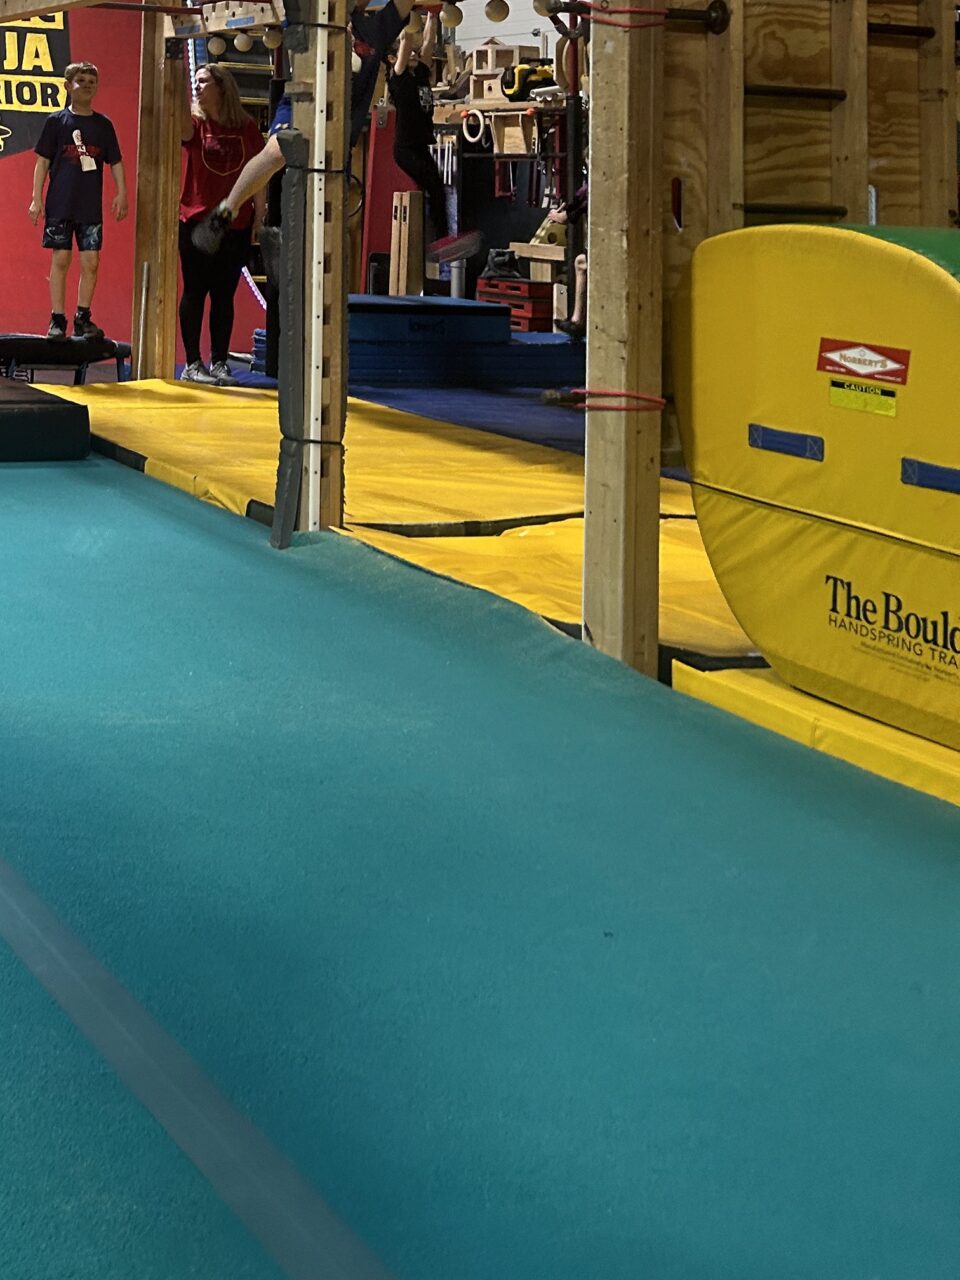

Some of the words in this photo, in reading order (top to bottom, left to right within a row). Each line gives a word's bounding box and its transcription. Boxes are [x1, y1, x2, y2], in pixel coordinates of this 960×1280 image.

[844, 382, 882, 395] CAUTION
[825, 575, 878, 625] The
[828, 614, 924, 657] HANDSPRING
